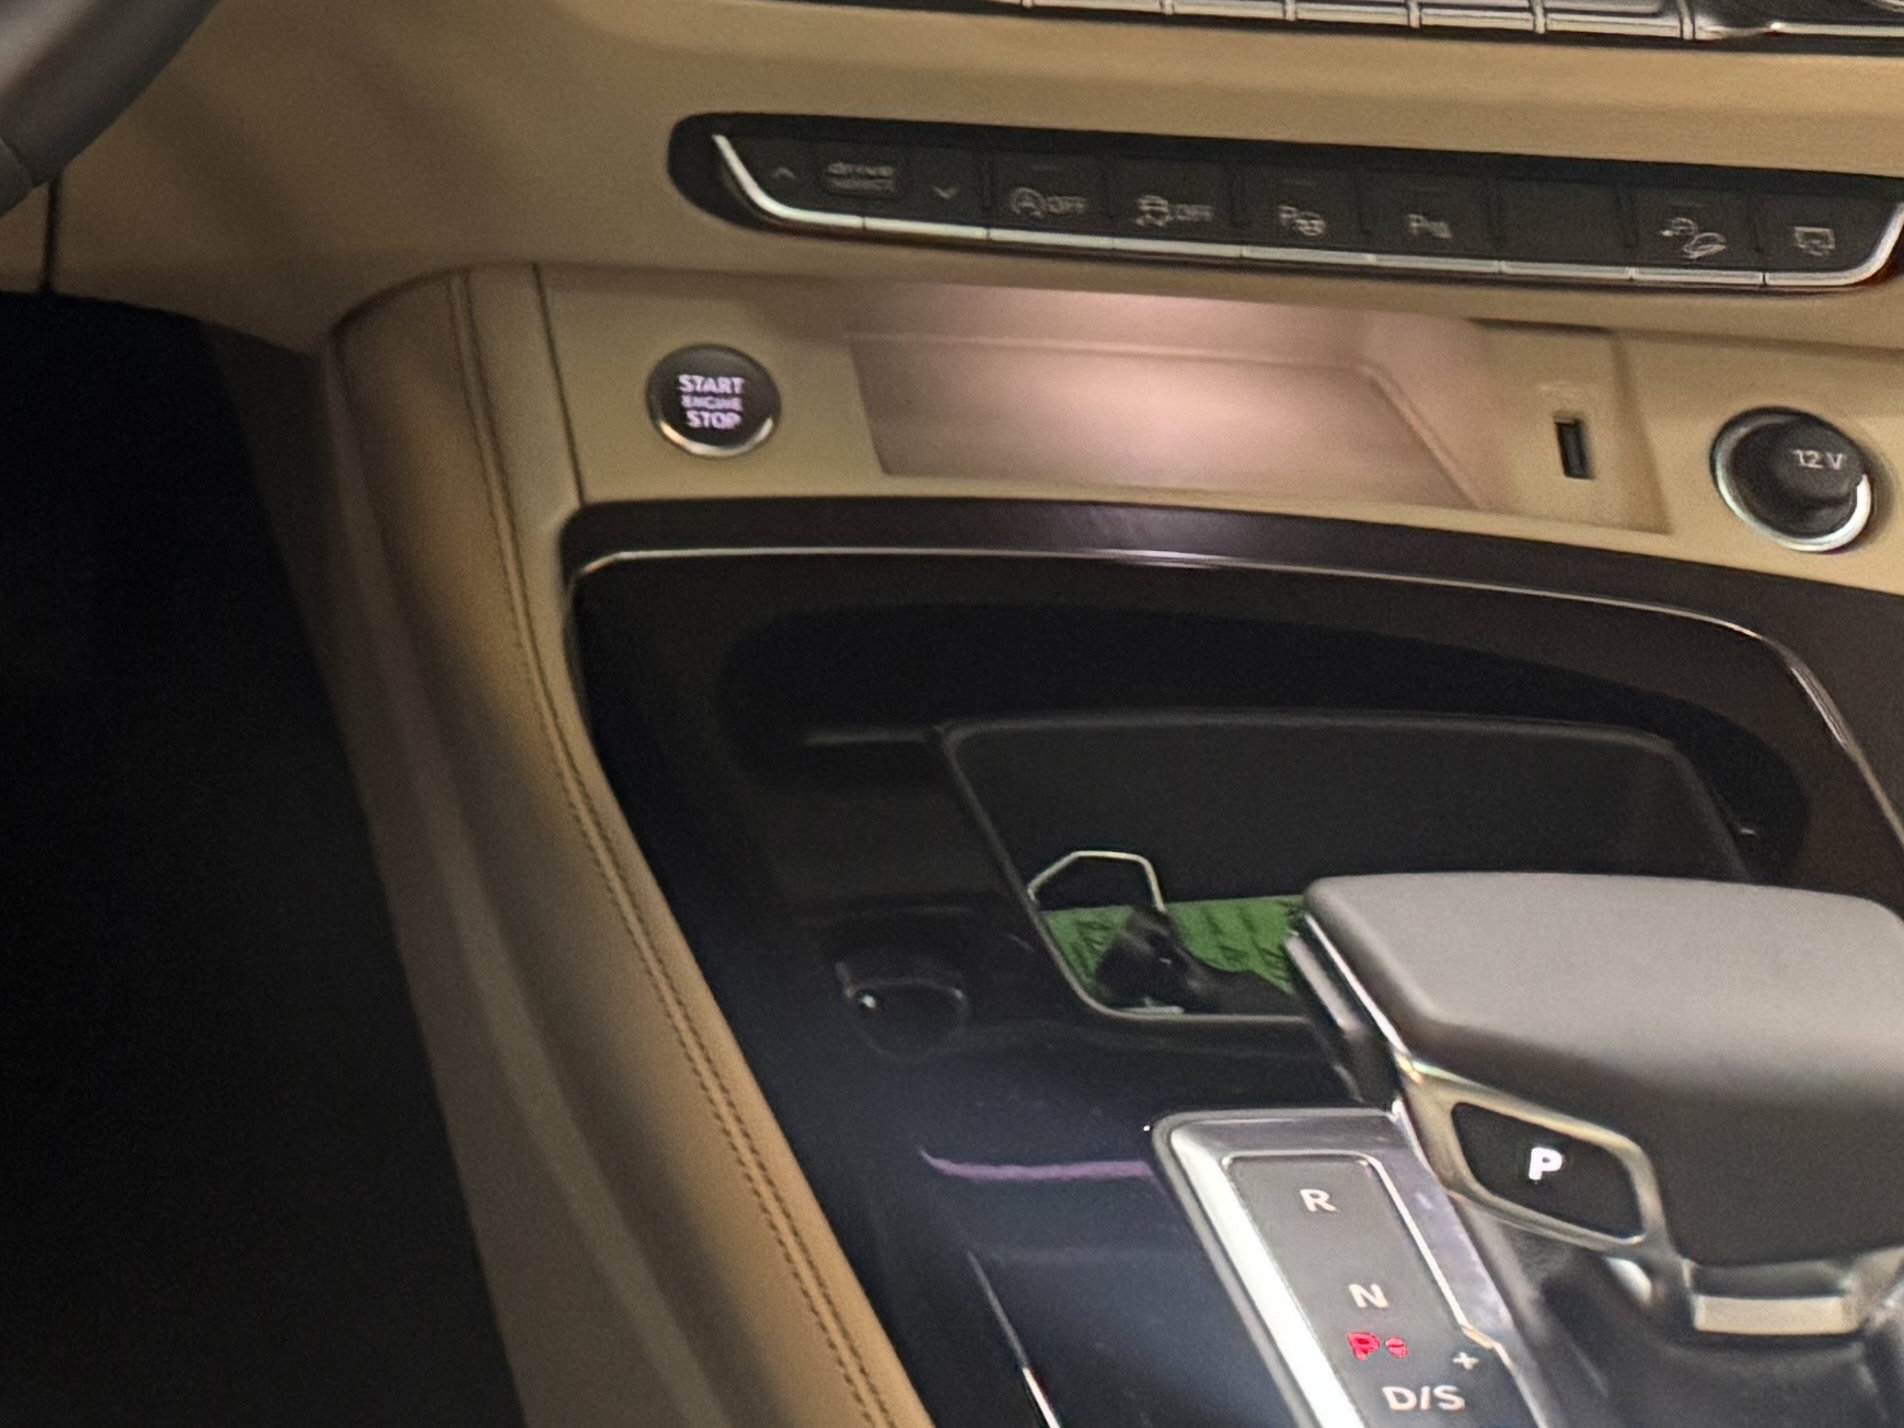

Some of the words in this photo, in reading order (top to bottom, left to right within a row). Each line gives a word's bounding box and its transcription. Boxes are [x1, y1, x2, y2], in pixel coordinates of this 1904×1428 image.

[678, 374, 745, 394] START
[685, 410, 742, 430] STOP
[1792, 448, 1823, 470] 12
[1825, 450, 1847, 471] V
[1528, 1147, 1564, 1181] P
[1300, 1187, 1336, 1214] R
[1349, 1282, 1389, 1309] N
